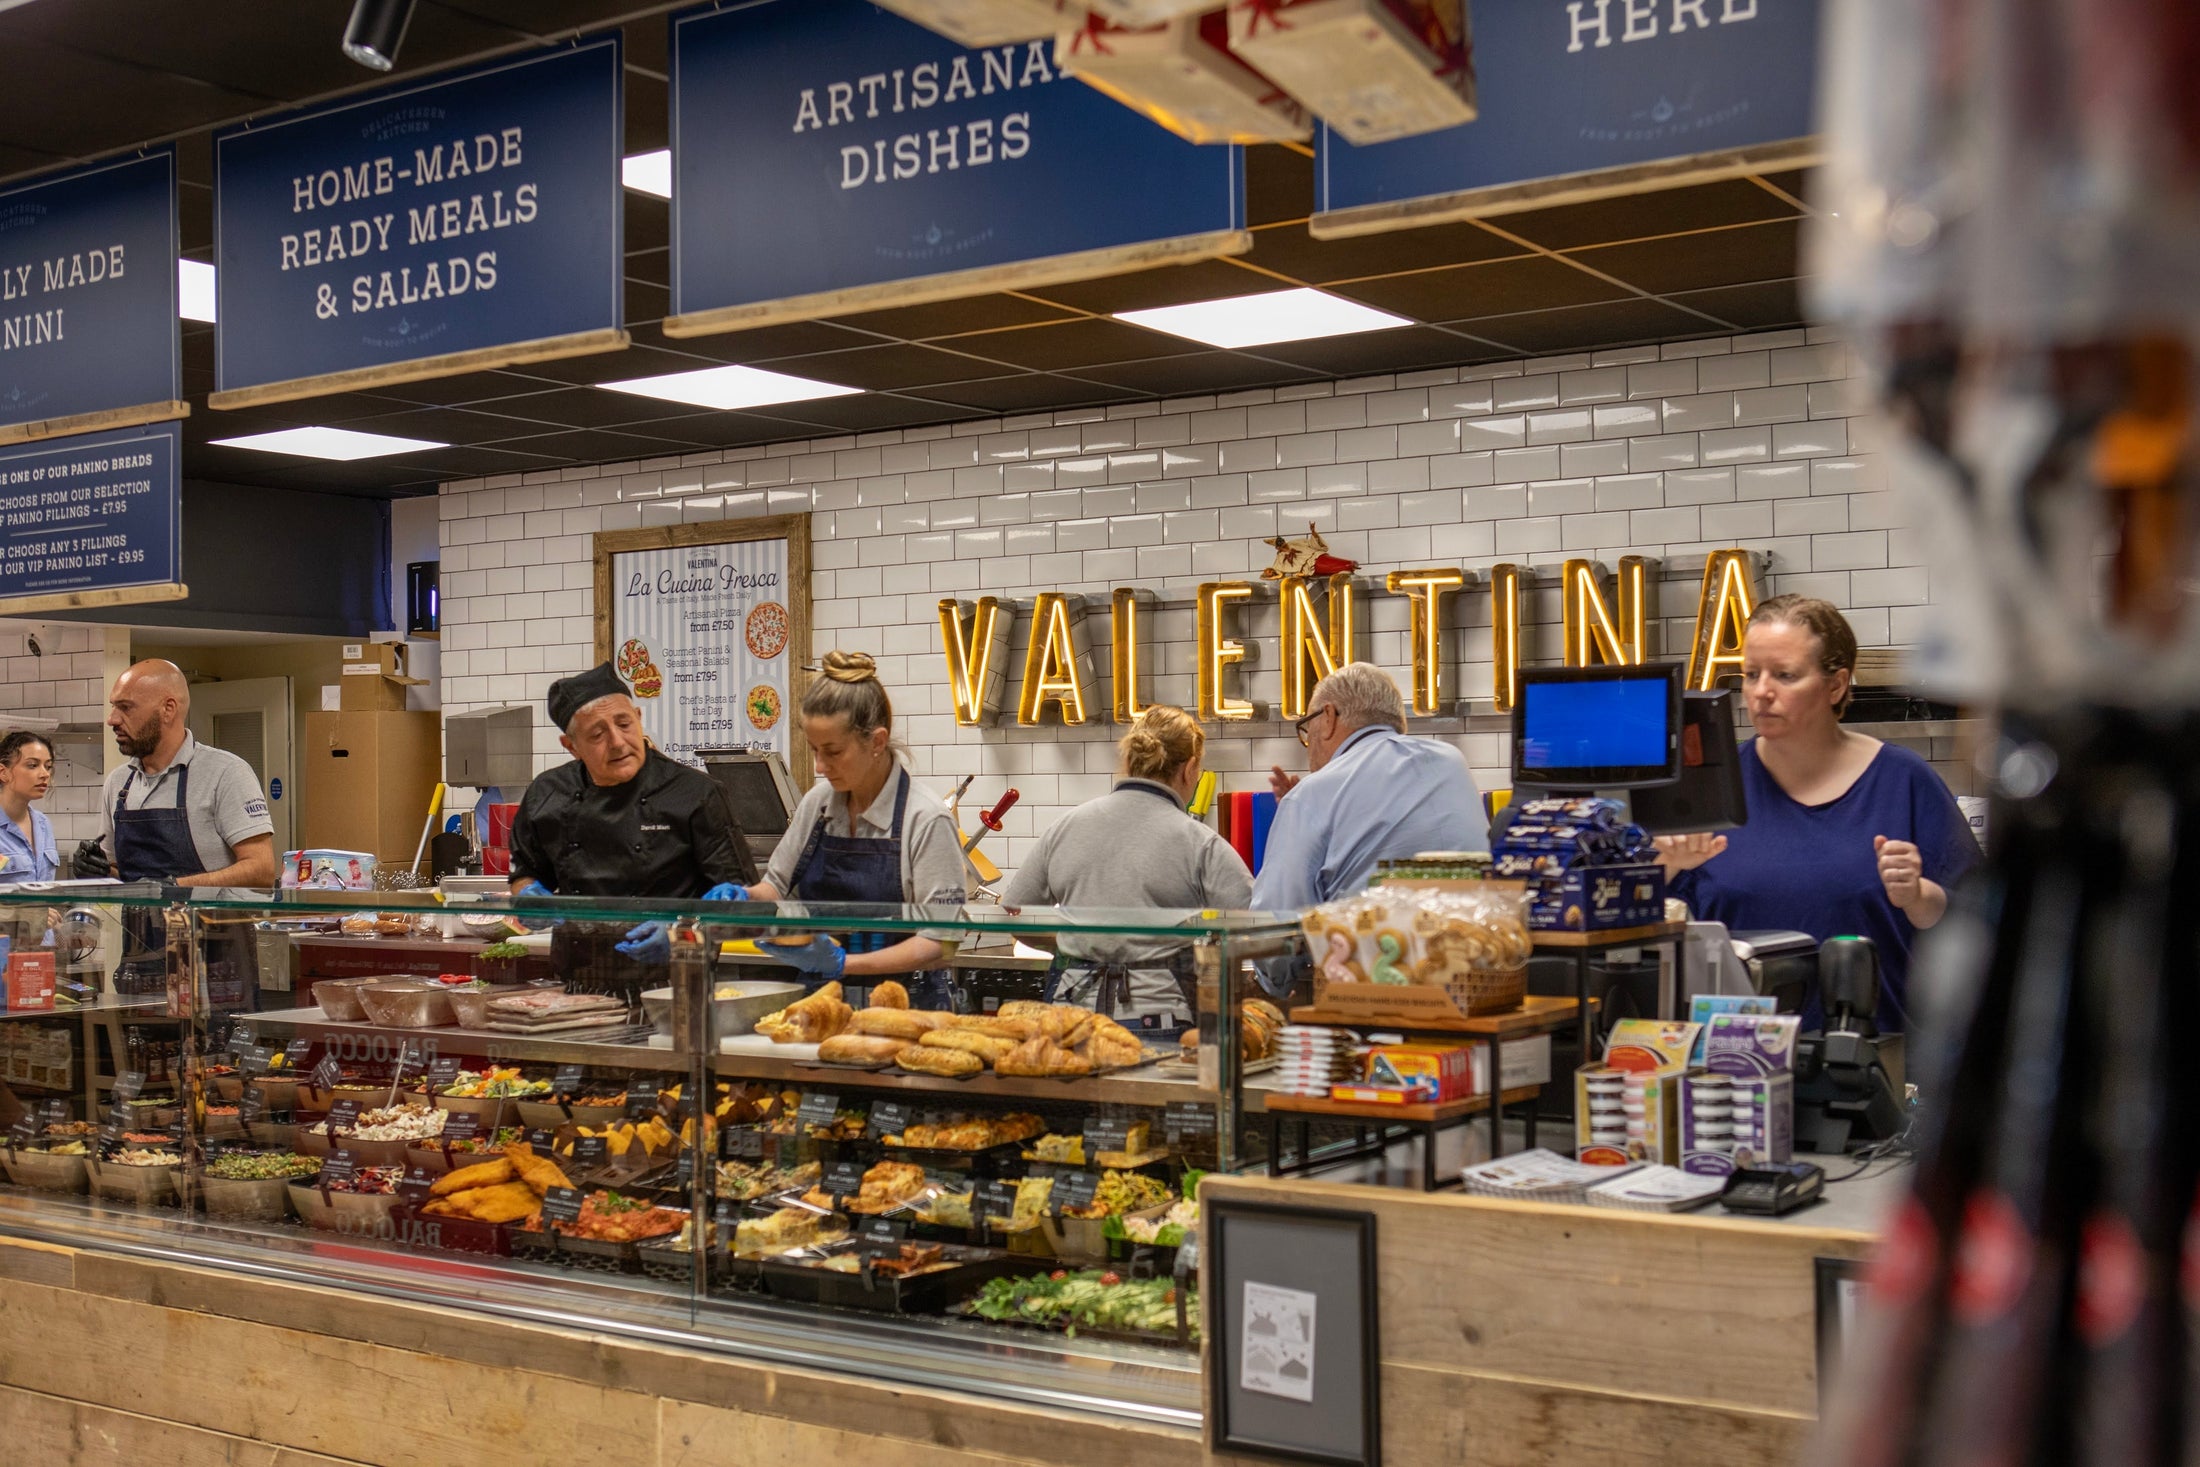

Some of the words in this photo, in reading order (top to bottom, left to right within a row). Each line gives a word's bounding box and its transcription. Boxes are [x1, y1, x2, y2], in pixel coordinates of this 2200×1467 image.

[792, 40, 1076, 133] ARTISANA
[840, 112, 1032, 189] DISHES
[293, 126, 522, 213] HOME-MADE
[281, 213, 395, 271] READY
[408, 183, 539, 245] MEALS
[43, 244, 124, 292] MADE
[315, 283, 339, 320] &
[352, 251, 497, 313] SALADS
[10, 470, 30, 484] ONE
[32, 468, 45, 481] OF
[48, 464, 68, 479] OUR
[71, 459, 108, 476] PANINO
[111, 453, 152, 471] BREADS
[0, 494, 38, 511] CHOOSE
[41, 490, 68, 505] FROM
[71, 488, 91, 501] OUR
[94, 480, 151, 499] SELECTION
[7, 510, 43, 526] PANINO
[46, 505, 90, 521] FILLINGS
[102, 500, 127, 515] £7.95
[7, 543, 47, 558] CHOOSE
[50, 540, 70, 554] ANY
[72, 539, 78, 552] 3
[81, 534, 127, 550] FILLINGS
[5, 562, 25, 575] OUR
[27, 559, 43, 573] VIP
[46, 555, 82, 571] PANINO
[85, 553, 108, 567] LIST
[118, 549, 145, 564] £9.95
[687, 558, 718, 570] VALENTINA
[626, 572, 652, 597] La
[657, 569, 715, 595] Cucina
[719, 564, 780, 590] Fresca
[683, 609, 718, 620] Artisanal
[720, 607, 742, 618] Pizza
[690, 622, 710, 632] from
[938, 548, 1760, 728] VALENTINA
[662, 647, 696, 657] Gourmet
[698, 645, 723, 655] Panini
[724, 644, 731, 654] &
[666, 658, 701, 668] Seasonal
[703, 656, 729, 667] Salads
[674, 672, 693, 683] from
[692, 707, 705, 716] the
[707, 706, 723, 717] Day
[705, 695, 727, 705] Pasta
[729, 694, 737, 704] of
[689, 720, 709, 731] from
[664, 744, 671, 752] A
[672, 743, 702, 752] Curated
[752, 741, 772, 751] Over
